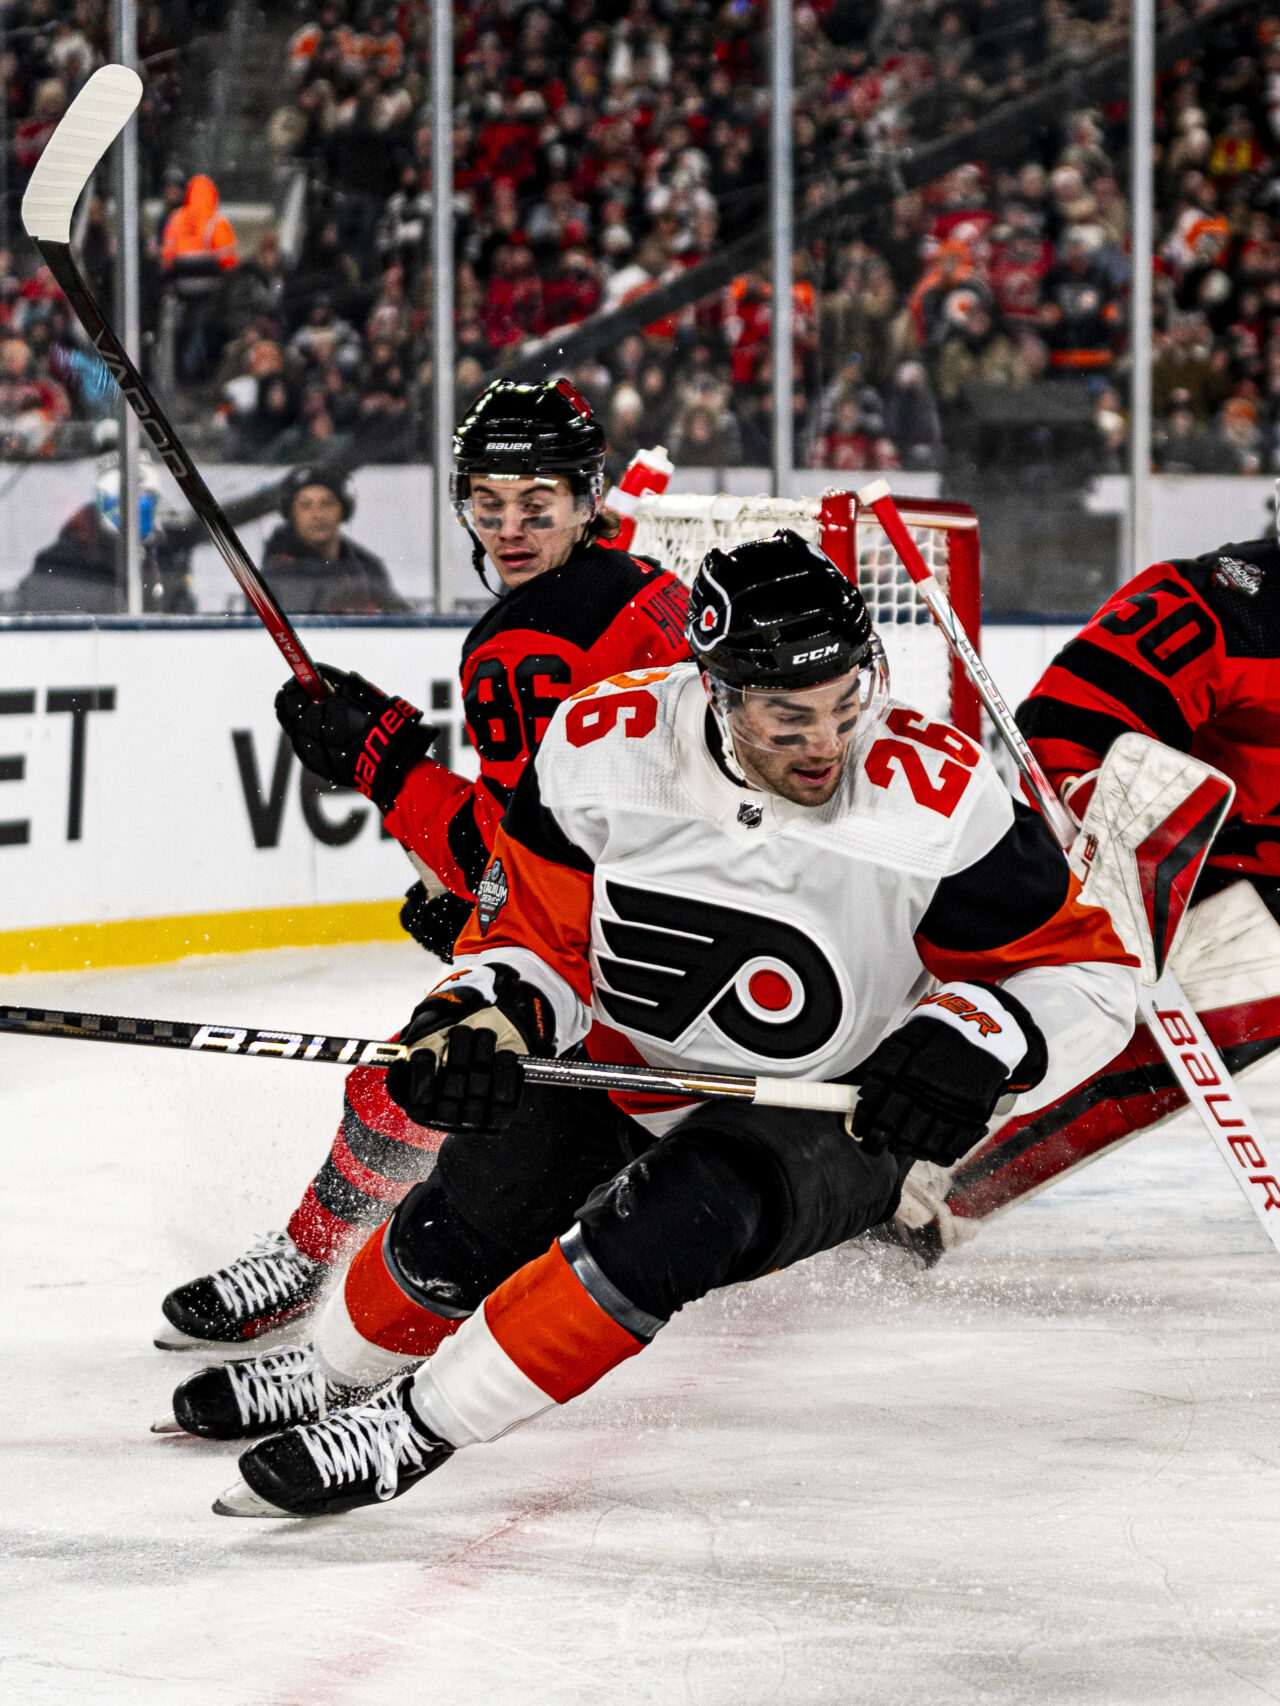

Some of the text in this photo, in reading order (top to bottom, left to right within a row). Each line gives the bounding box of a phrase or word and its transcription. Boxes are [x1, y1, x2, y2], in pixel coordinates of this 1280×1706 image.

[485, 442, 533, 451] BAUER
[792, 642, 840, 665] CCM
[1099, 579, 1217, 677] 50
[464, 654, 572, 762] 86
[865, 708, 981, 818] 26
[479, 880, 508, 899] STADIUM
